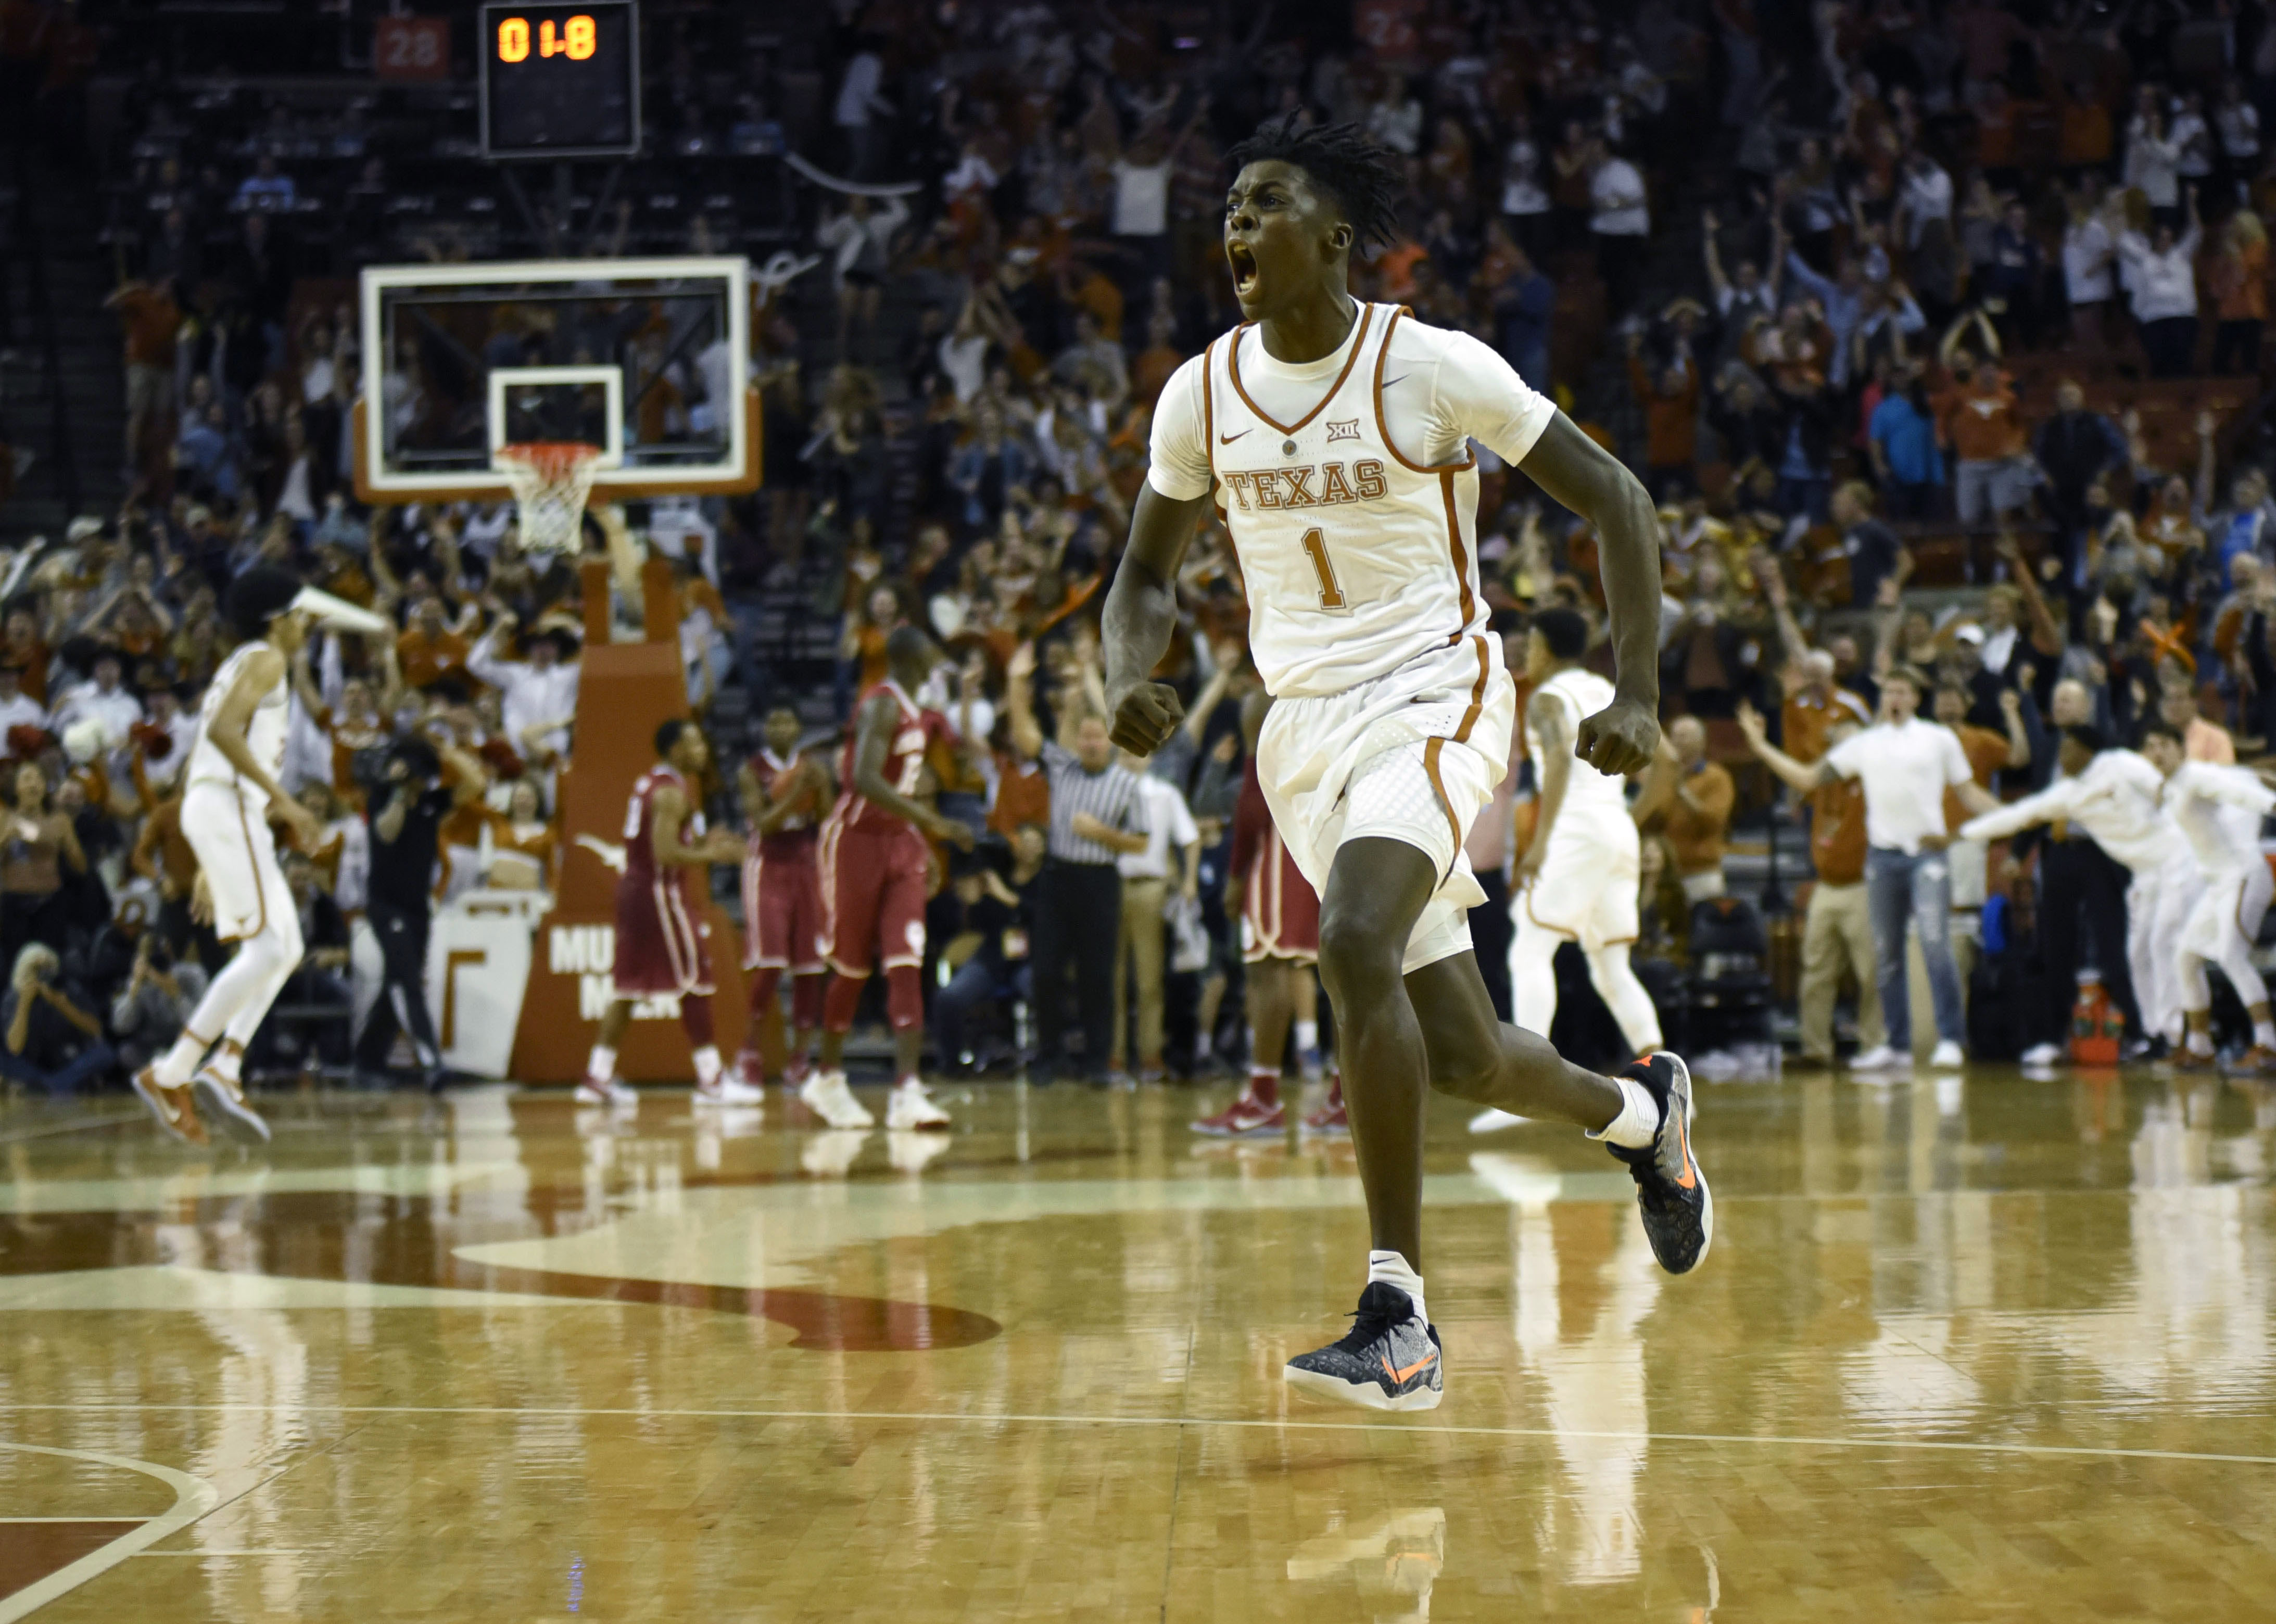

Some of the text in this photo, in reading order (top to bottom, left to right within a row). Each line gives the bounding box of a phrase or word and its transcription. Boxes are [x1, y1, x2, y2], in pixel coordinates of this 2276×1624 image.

[386, 28, 439, 67] 28
[1326, 418, 1361, 442] XII
[1221, 459, 1388, 510] TEXAS
[1301, 527, 1347, 610] 1
